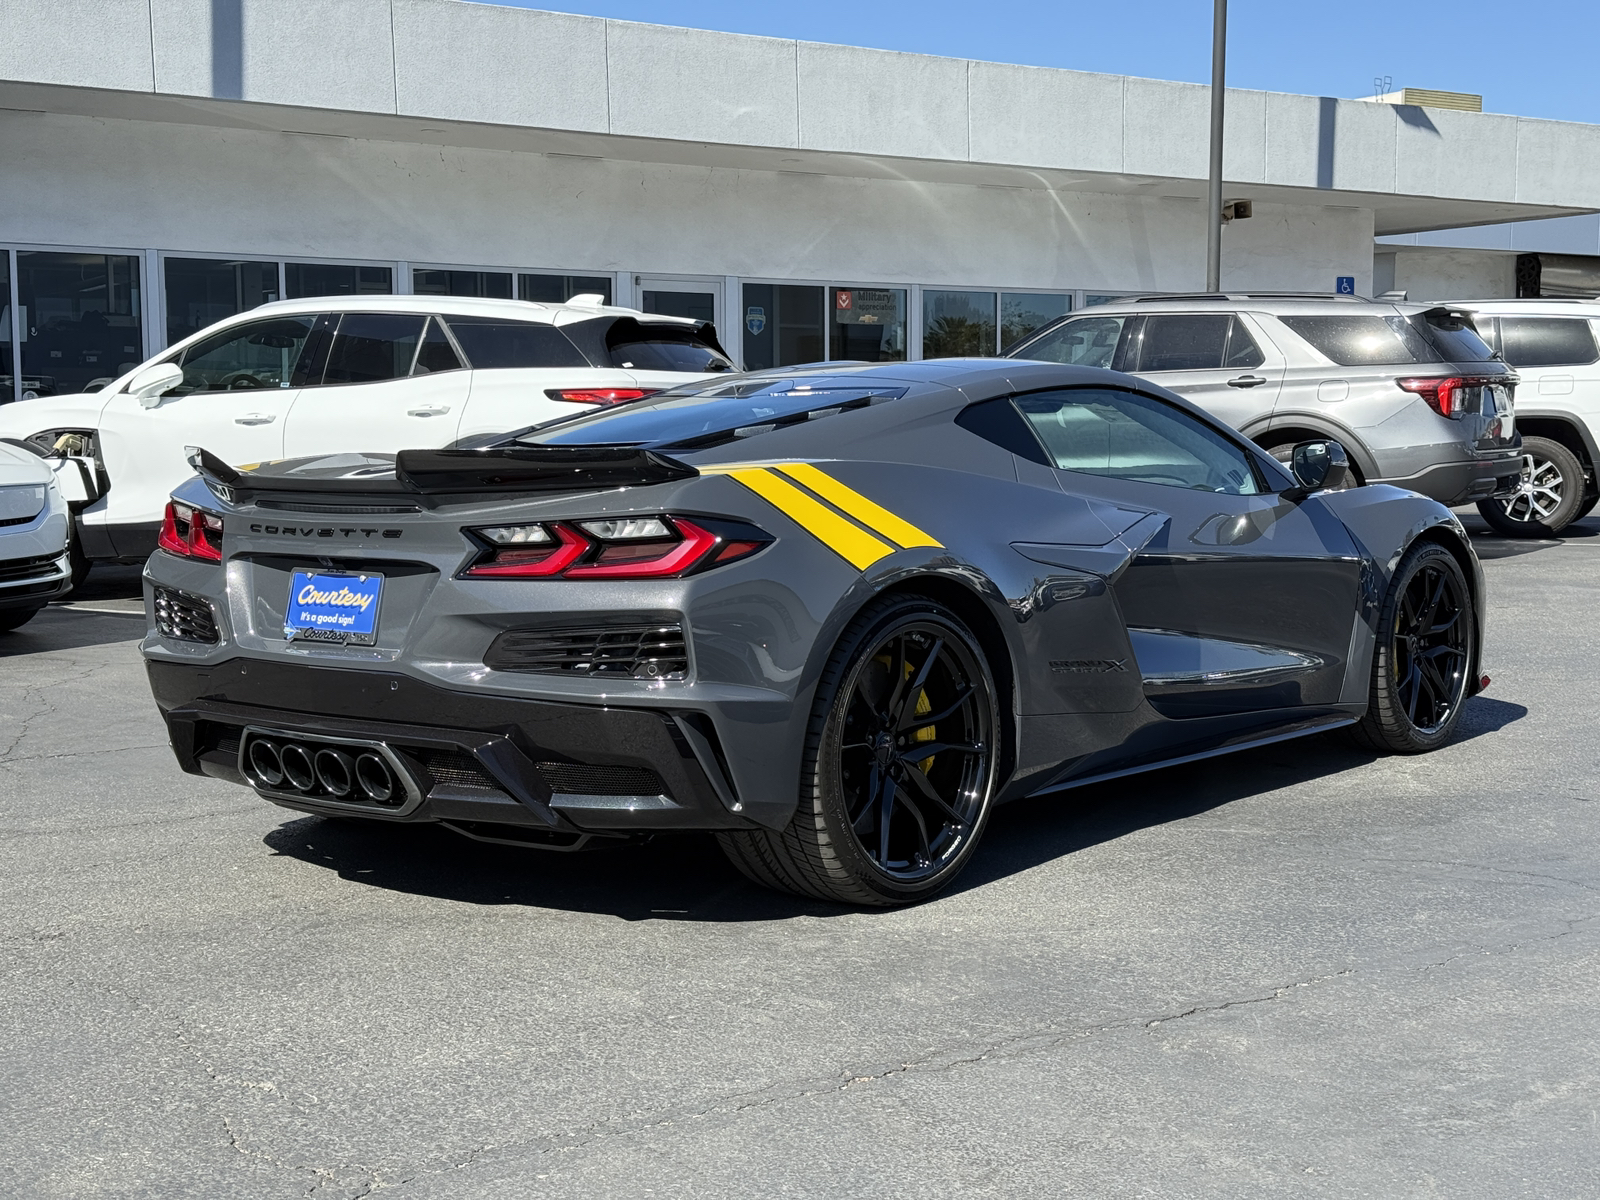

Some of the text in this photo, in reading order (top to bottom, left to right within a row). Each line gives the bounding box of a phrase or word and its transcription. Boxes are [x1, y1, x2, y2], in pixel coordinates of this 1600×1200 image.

[858, 291, 891, 303] Military
[858, 303, 897, 311] appreciation
[250, 524, 403, 538] CORVETTE
[297, 584, 374, 611] Courtesy
[300, 611, 356, 627] It's a good sign!
[304, 627, 349, 643] Courtesy
